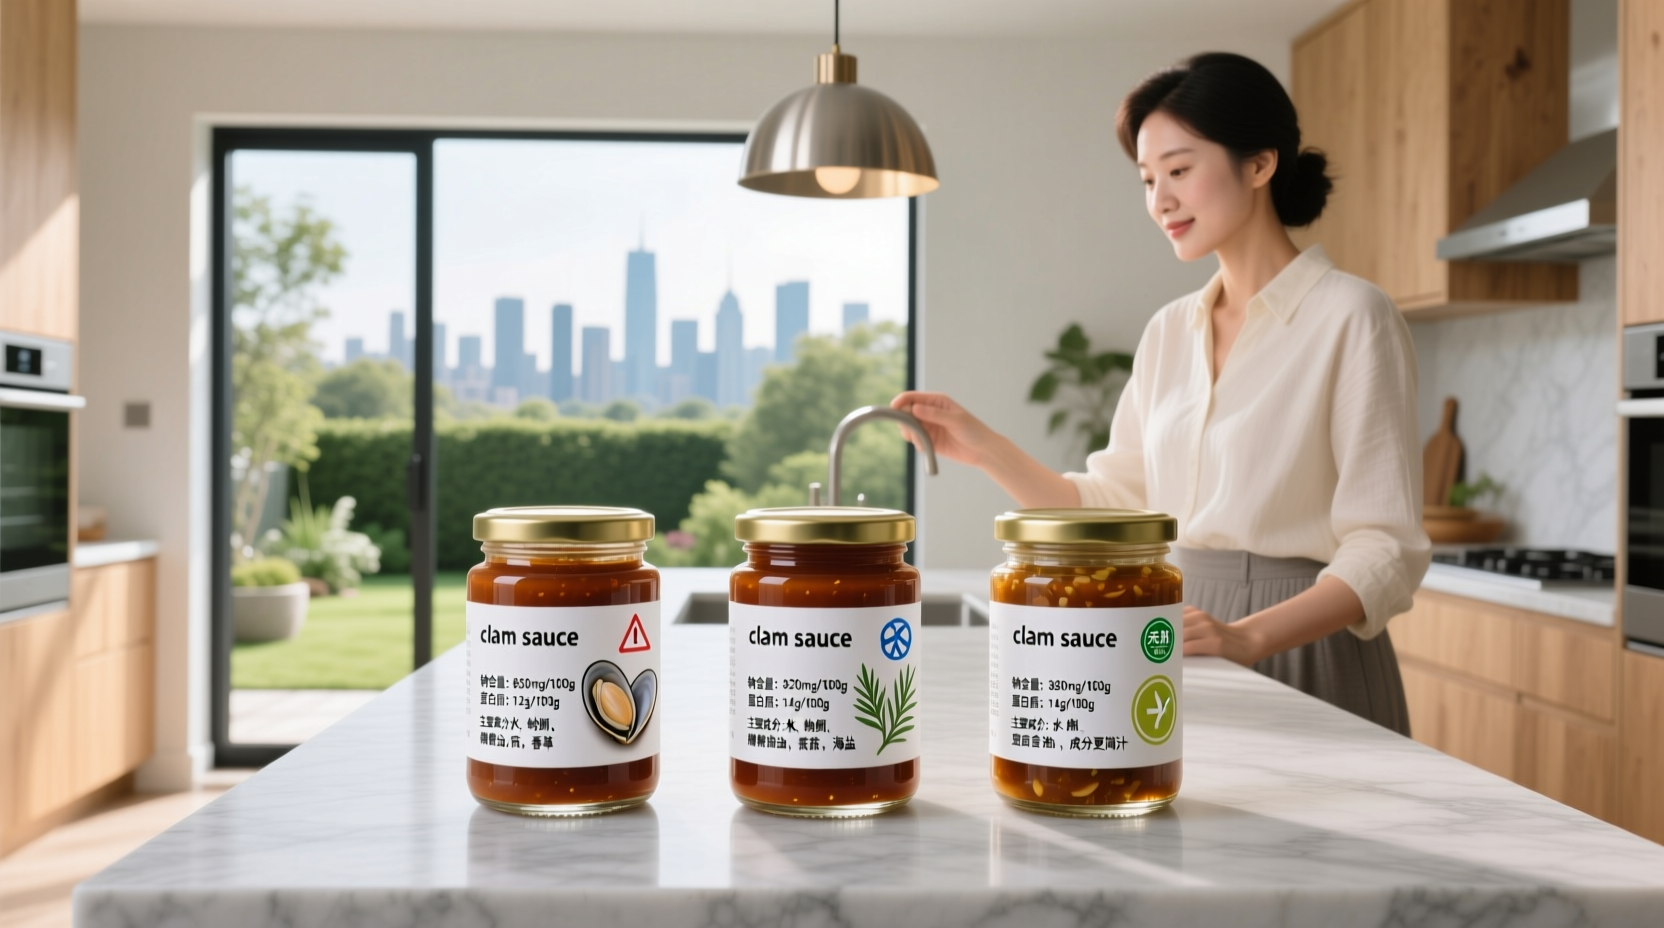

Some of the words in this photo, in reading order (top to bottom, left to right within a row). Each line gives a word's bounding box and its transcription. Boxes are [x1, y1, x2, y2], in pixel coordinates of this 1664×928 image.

[481, 625, 516, 645] clam
[523, 631, 579, 646] sauce
[749, 626, 788, 646] clam
[795, 633, 852, 648] sauce
[1013, 625, 1054, 646] clam
[1061, 633, 1117, 648] sauce
